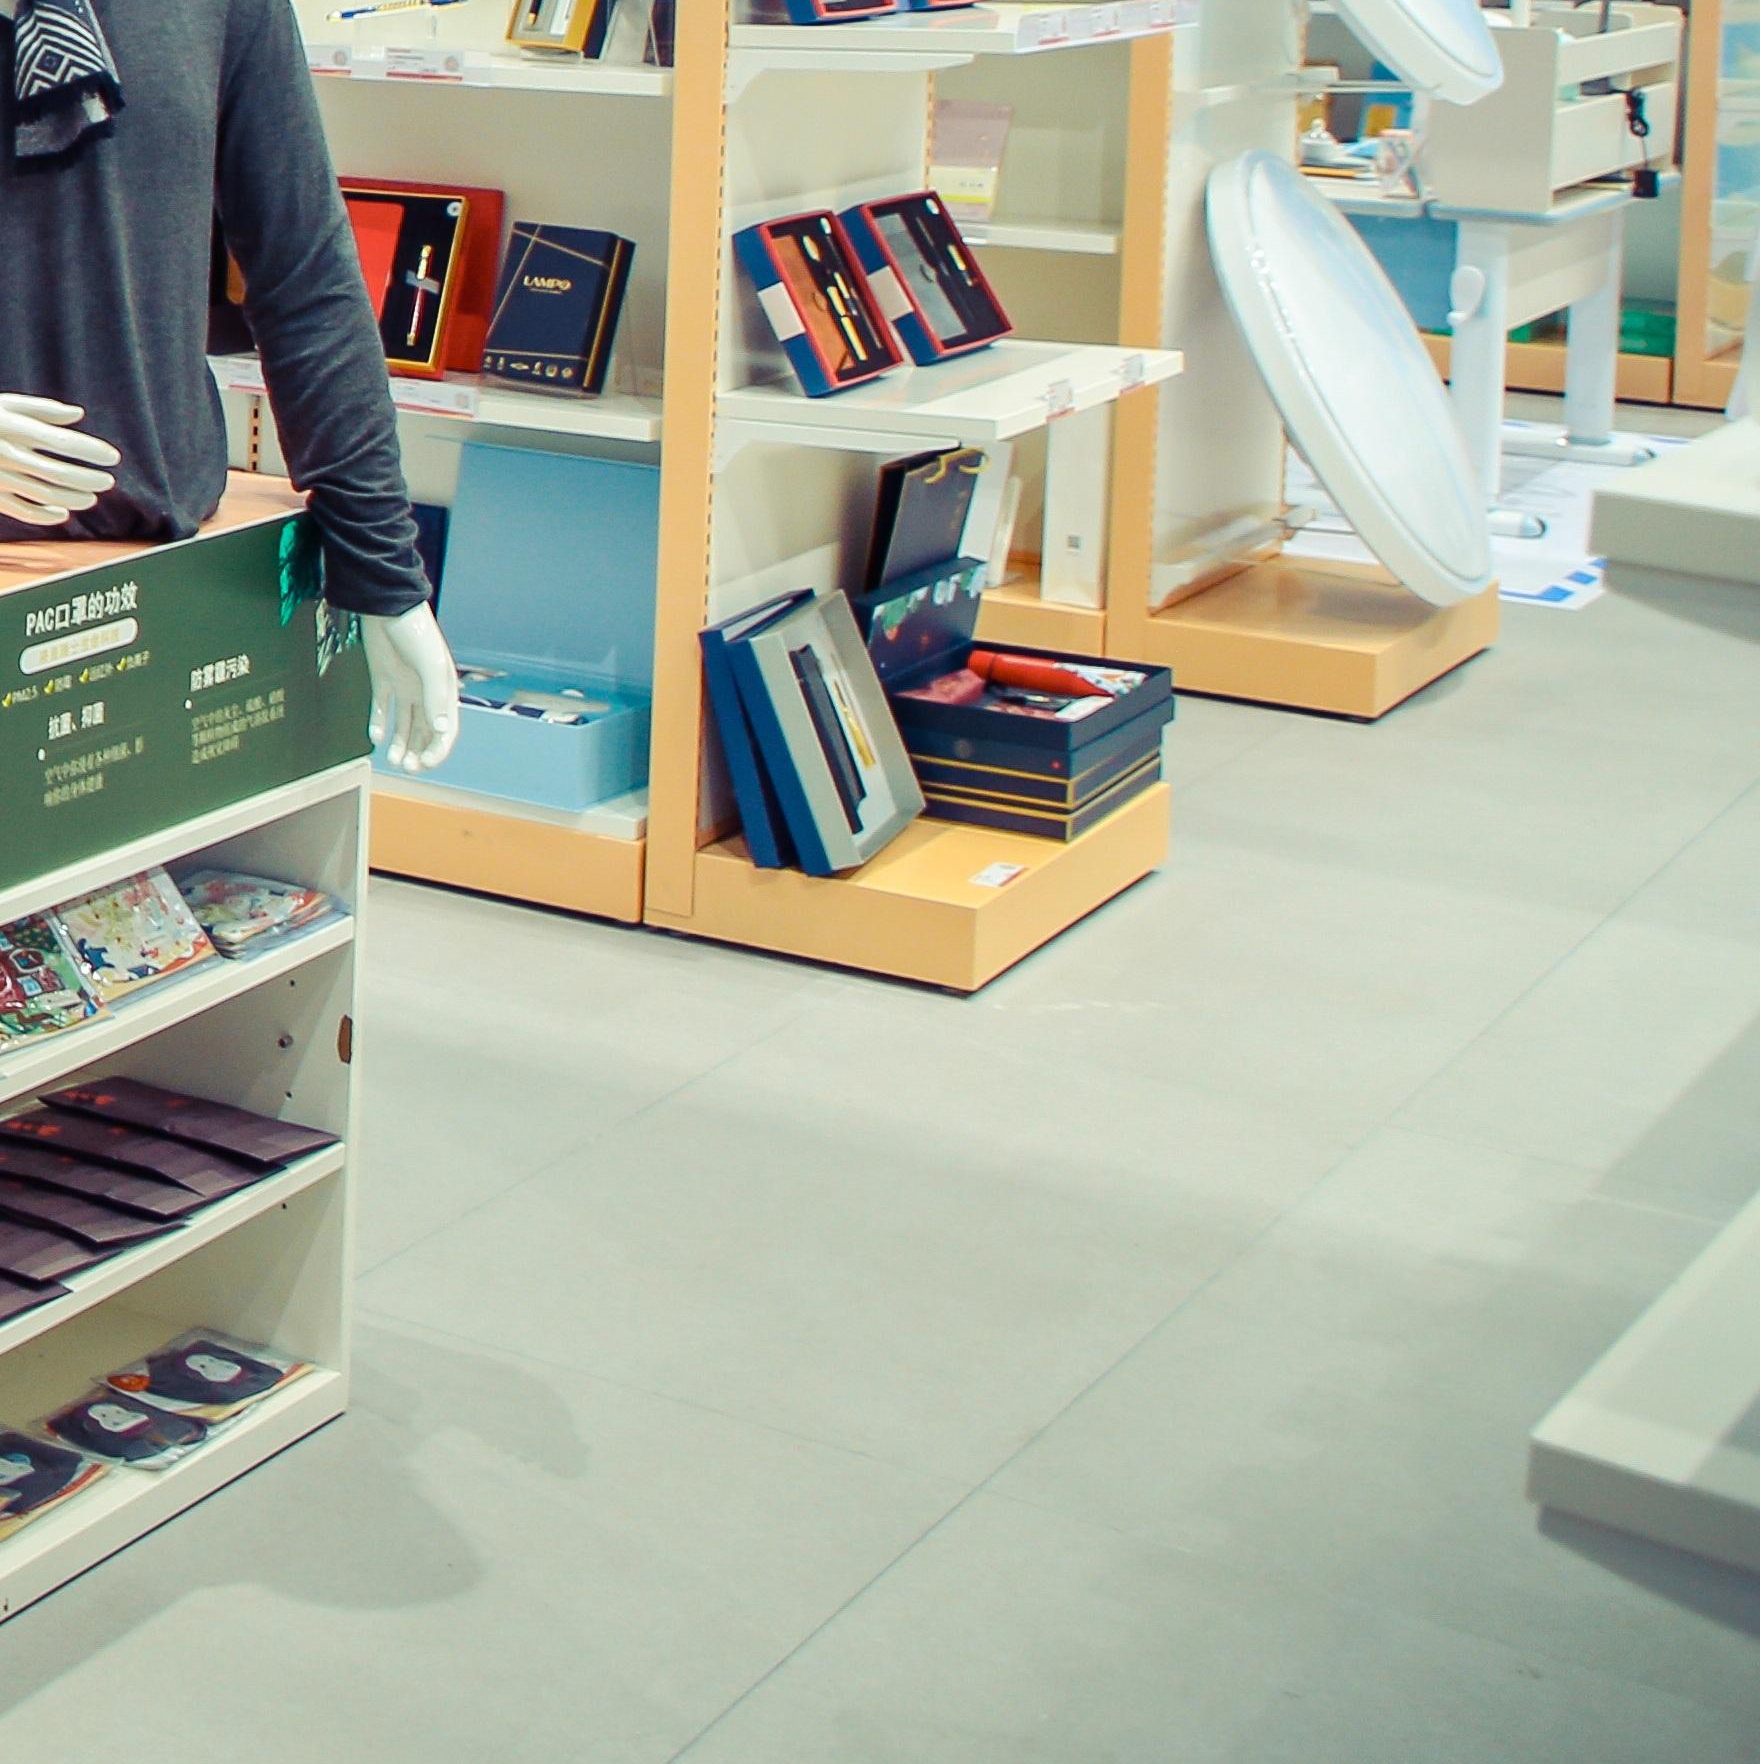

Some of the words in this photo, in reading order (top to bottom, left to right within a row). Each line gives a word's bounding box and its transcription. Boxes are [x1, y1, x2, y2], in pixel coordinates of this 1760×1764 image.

[25, 580, 140, 637] PAC口罩的功效
